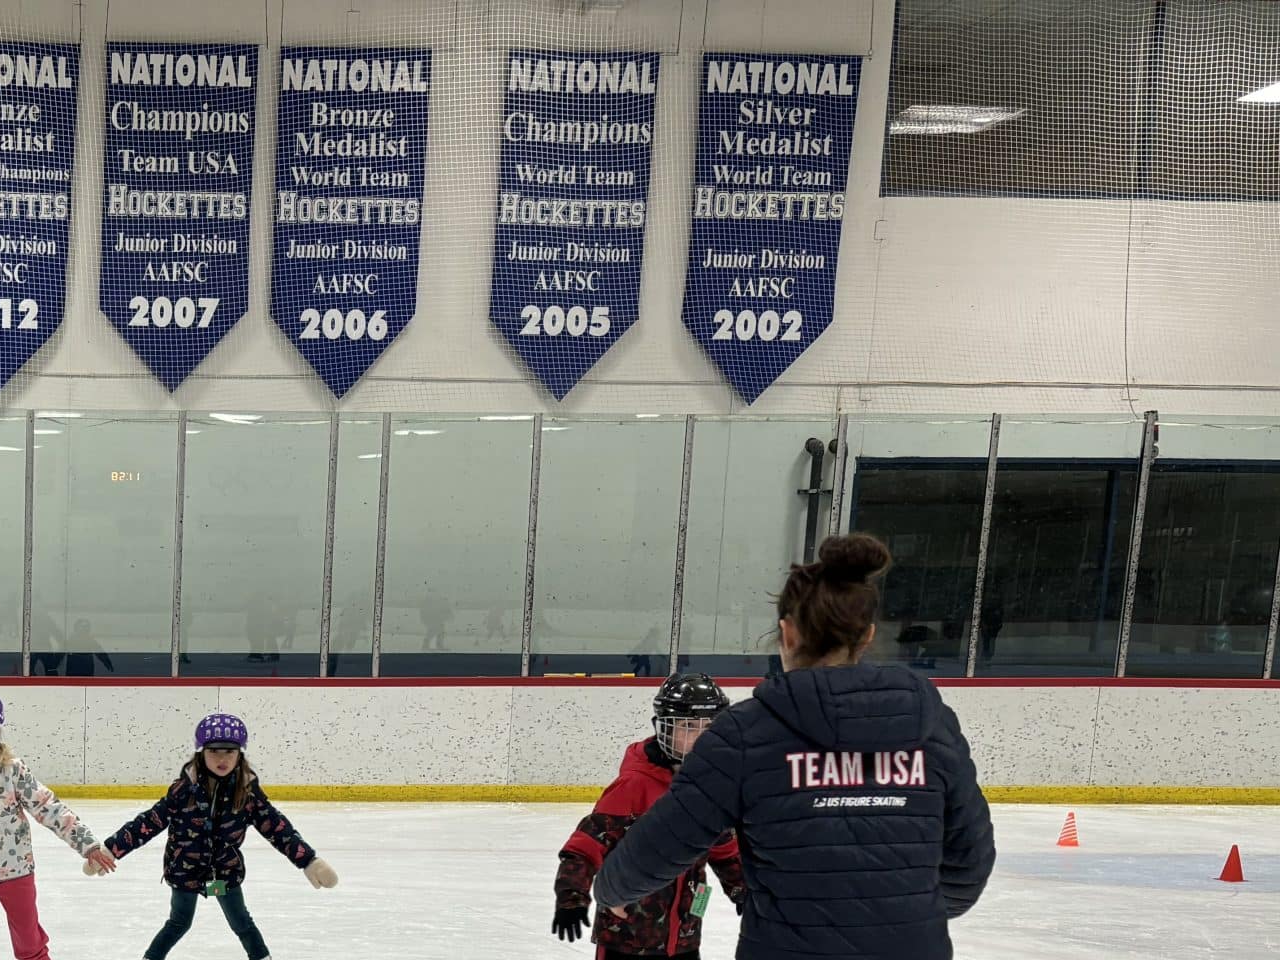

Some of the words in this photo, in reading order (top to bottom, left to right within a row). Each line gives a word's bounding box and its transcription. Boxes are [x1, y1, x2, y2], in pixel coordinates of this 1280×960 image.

[111, 53, 252, 87] NATIONAL
[283, 58, 427, 92] NATIONAL
[508, 60, 655, 94] NATIONAL
[708, 61, 853, 96] NATIONAL
[111, 101, 249, 139] Champions
[311, 103, 394, 127] Bronze
[738, 101, 817, 125] Silver
[504, 113, 651, 150] Champions
[718, 131, 832, 156] Medalist
[295, 133, 408, 157] Medalist
[118, 150, 179, 174] Team
[188, 151, 238, 175] USA
[291, 167, 352, 186] World
[357, 168, 408, 187] Team
[517, 165, 576, 185] World
[582, 166, 634, 186] Team
[713, 165, 773, 185] World
[780, 166, 831, 186] Team
[109, 184, 247, 219] HOCKETTES
[278, 191, 419, 225] HOCKETTES
[499, 193, 645, 227] HOCKETTES
[694, 186, 845, 220] HOCKETTES
[115, 233, 167, 252] Junior
[173, 234, 237, 254] Division
[287, 240, 339, 259] Junior
[344, 240, 407, 260] Division
[508, 241, 561, 262] Junior
[566, 242, 630, 262] Division
[703, 249, 756, 268] Junior
[761, 250, 824, 269] Division
[143, 262, 209, 282] AAFSC
[312, 274, 378, 295] AAFSC
[534, 271, 601, 291] AAFSC
[729, 277, 795, 298] AAFSC
[128, 297, 220, 328] 2007
[300, 308, 388, 340] 2006
[520, 305, 611, 336] 2005
[712, 310, 802, 341] 2002
[786, 752, 864, 788] TEAM
[874, 750, 926, 785] USA
[827, 797, 840, 807] US
[840, 796, 872, 807] FIGURE
[871, 796, 907, 807] SKATING
